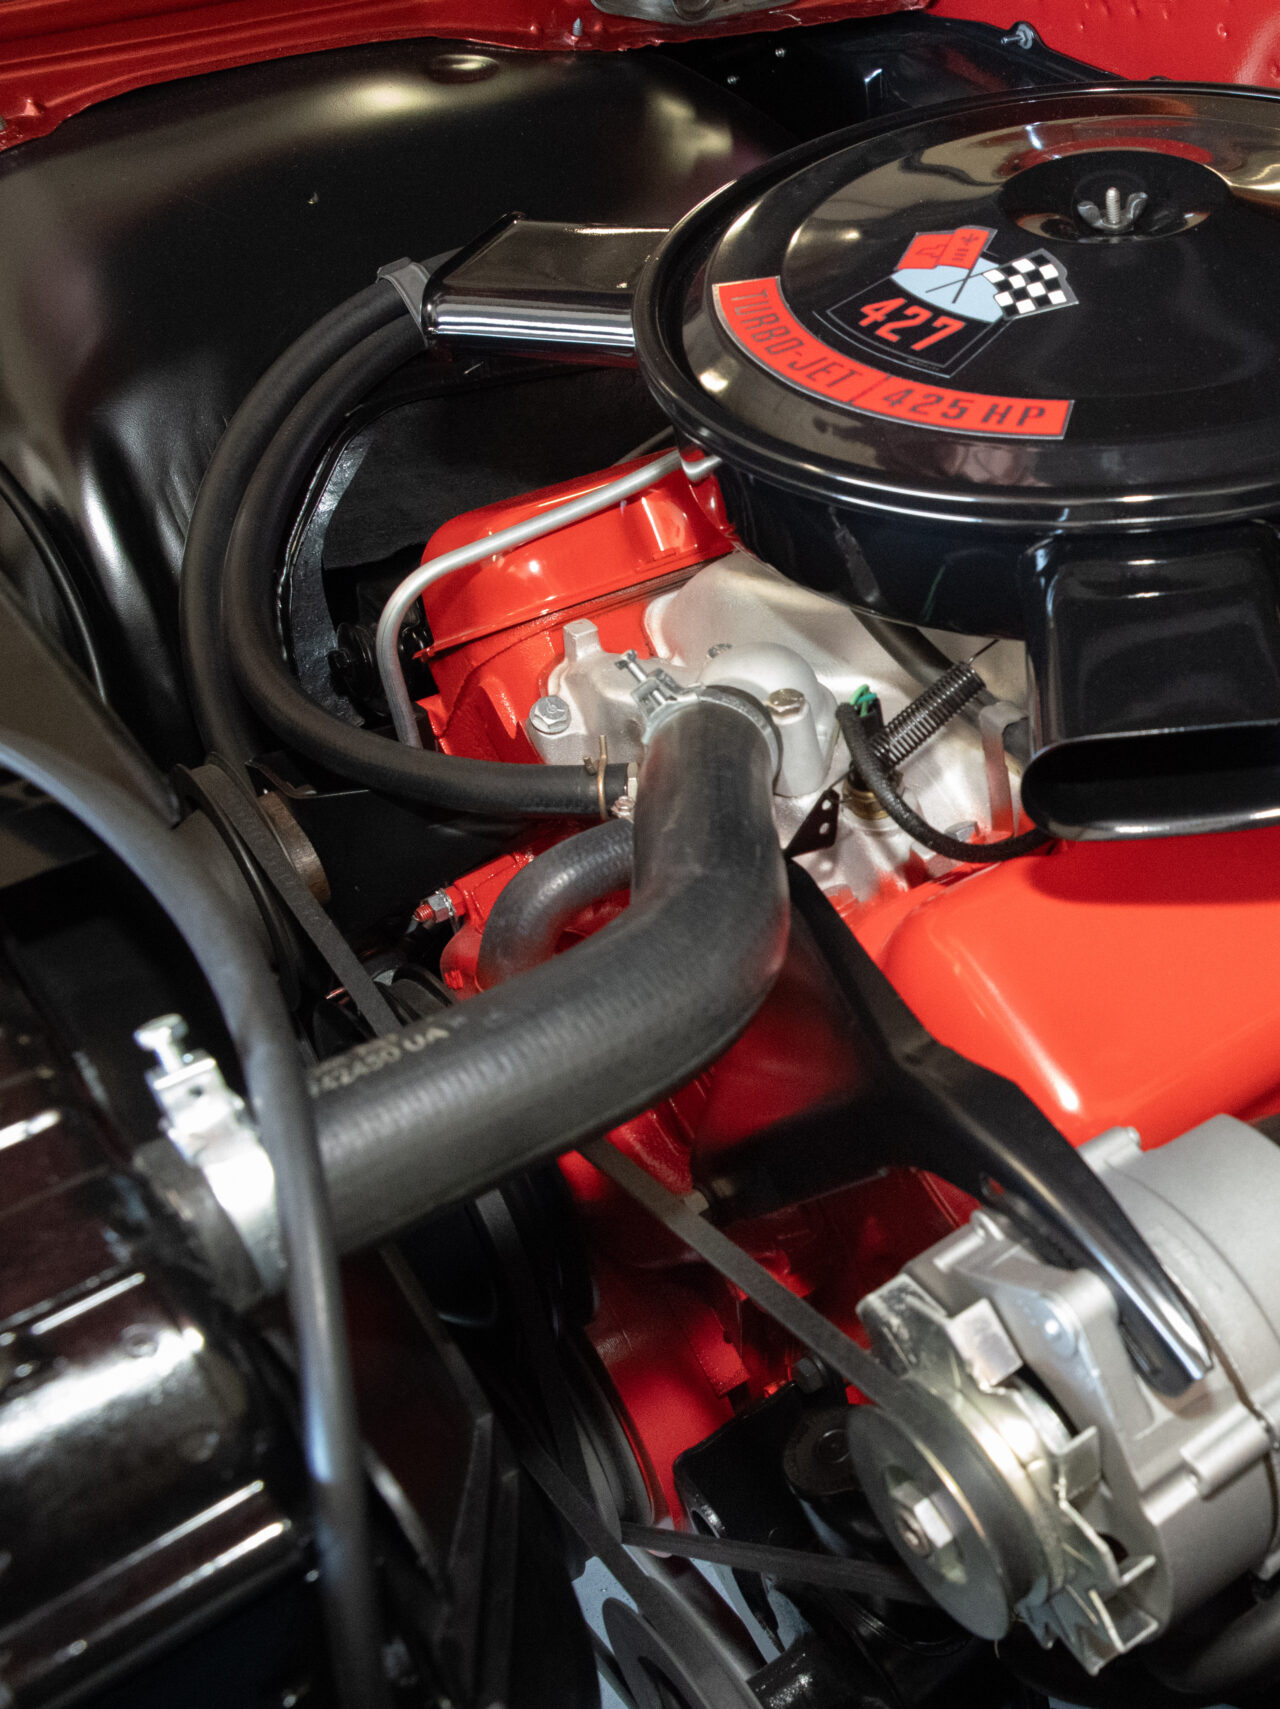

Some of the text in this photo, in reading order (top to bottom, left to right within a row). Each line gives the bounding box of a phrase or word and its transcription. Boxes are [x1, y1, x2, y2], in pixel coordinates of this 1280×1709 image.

[730, 287, 1045, 426] TURBO-JET 425 HP
[858, 298, 966, 351] 427
